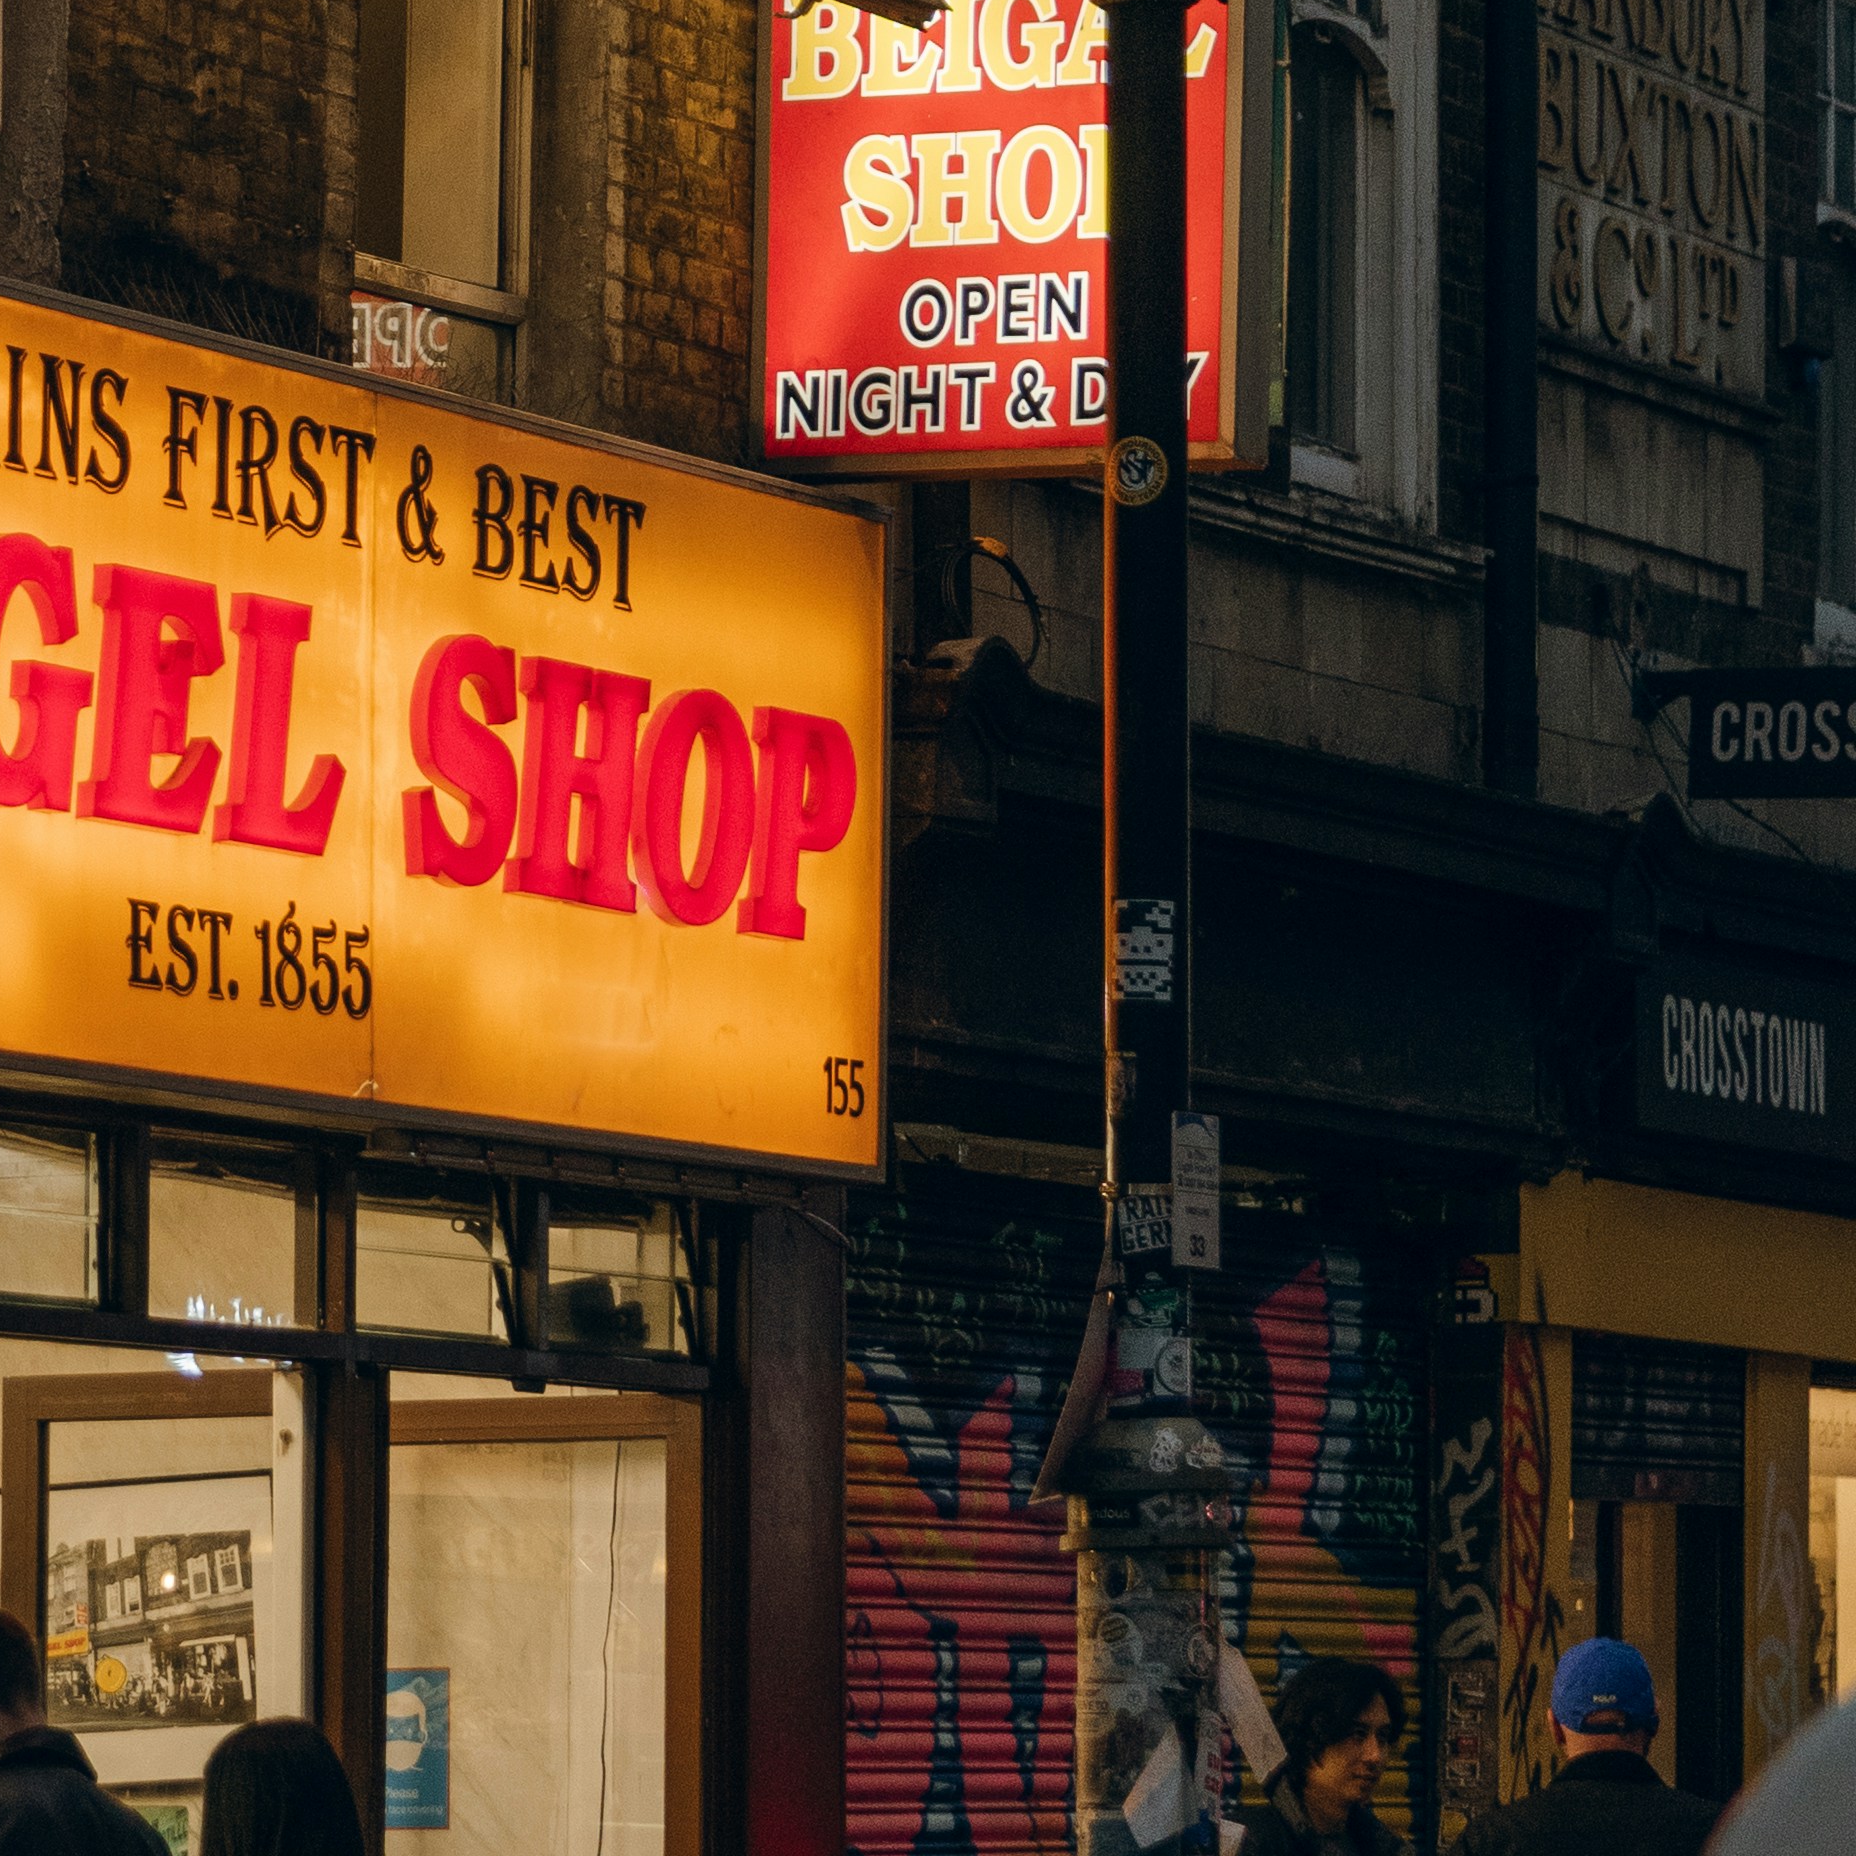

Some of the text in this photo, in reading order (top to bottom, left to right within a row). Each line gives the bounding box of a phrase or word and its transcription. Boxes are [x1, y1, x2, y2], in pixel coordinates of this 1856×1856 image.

[1537, 46, 1762, 247] BUXTON
[899, 271, 1089, 348] OPEN
[1549, 196, 1582, 331] &
[776, 350, 1210, 441] NIGHT & DY
[163, 385, 377, 548] FIRST
[396, 444, 446, 567] &
[472, 462, 648, 613] BEST
[402, 633, 859, 943] SHOP
[1710, 699, 1856, 763] CROS
[126, 897, 374, 1023] EST. 1855
[823, 1055, 865, 1120] 155
[1661, 992, 1828, 1116] CROSSTOWN
